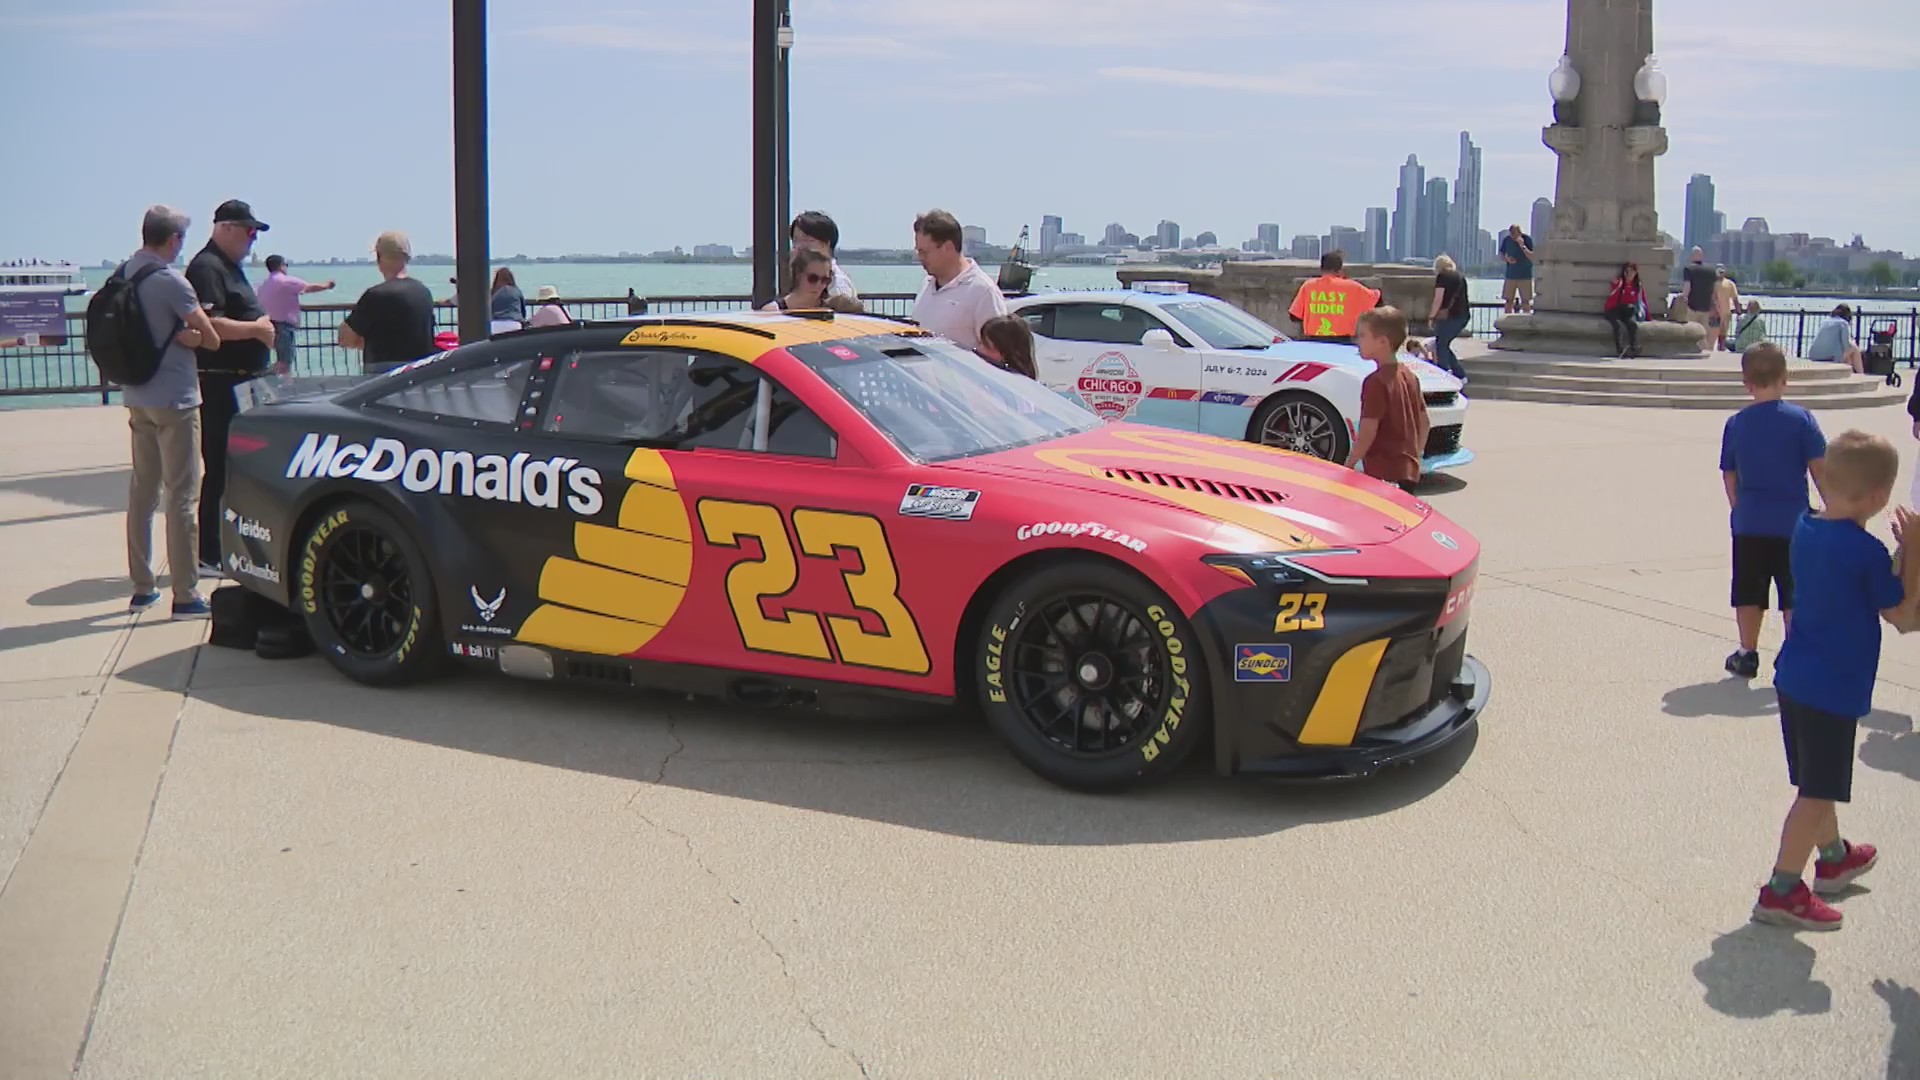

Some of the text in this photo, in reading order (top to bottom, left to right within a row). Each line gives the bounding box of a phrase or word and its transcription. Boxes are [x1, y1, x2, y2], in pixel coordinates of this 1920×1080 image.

[1309, 303, 1345, 315] RIDER
[1310, 291, 1346, 302] EASY
[1204, 365, 1226, 374] JULY
[1245, 367, 1268, 377] 2024
[1083, 379, 1137, 393] CHICAGO
[285, 432, 603, 516] McDonald's
[239, 515, 271, 542] leidos
[1017, 521, 1148, 553] GOODYEAR
[239, 555, 280, 584] Columbia
[302, 509, 350, 614] GOODYEAR
[696, 496, 932, 677] 23
[1274, 592, 1328, 634] 23
[475, 625, 488, 633] AIR
[488, 626, 512, 634] FORCE
[452, 642, 483, 658] Mobil
[986, 623, 1008, 702] EAGLE
[1239, 658, 1287, 670] SUNOCO
[1141, 605, 1190, 762] GOODYEAR
